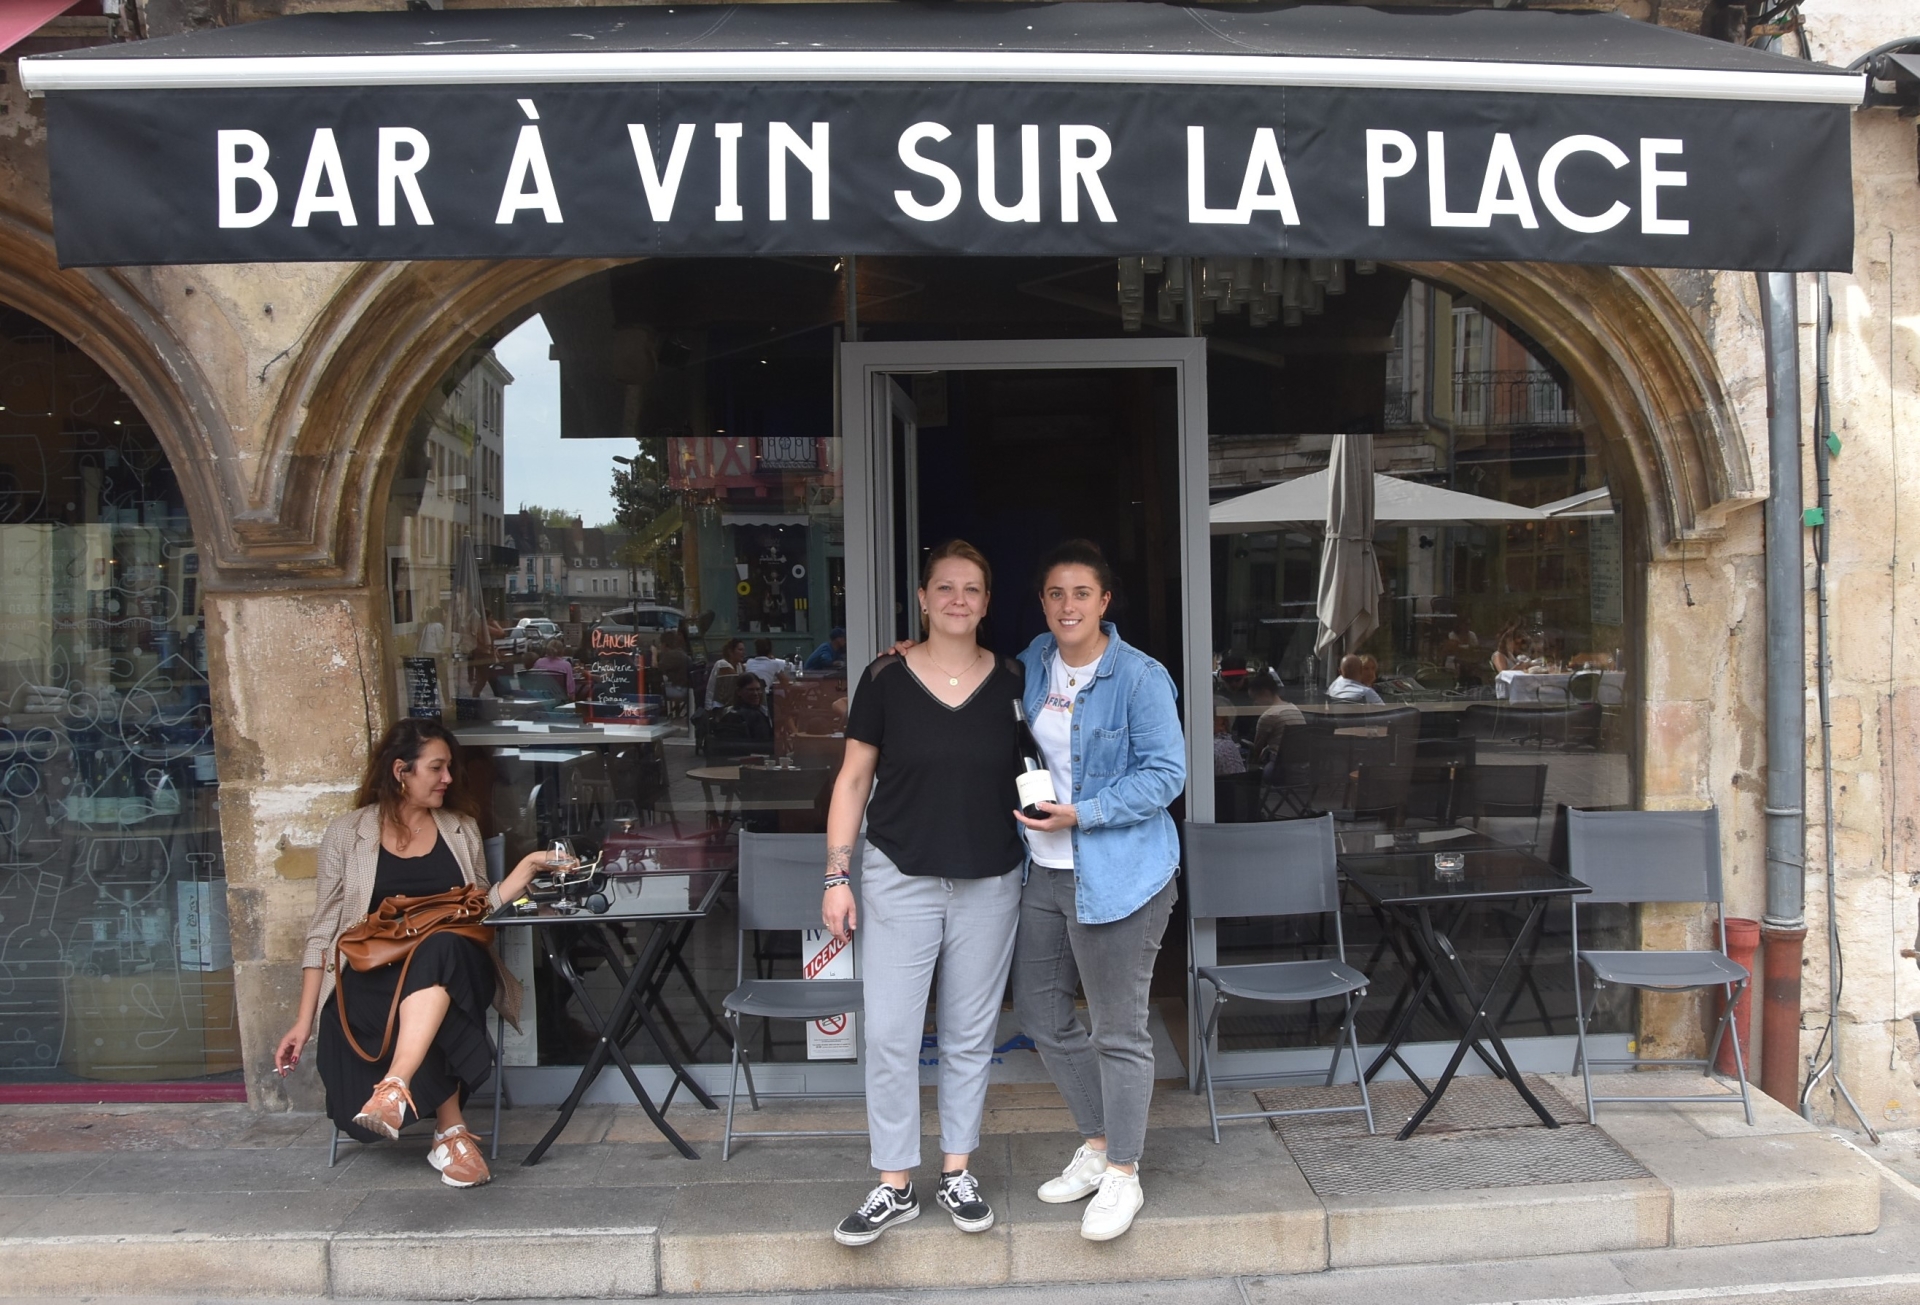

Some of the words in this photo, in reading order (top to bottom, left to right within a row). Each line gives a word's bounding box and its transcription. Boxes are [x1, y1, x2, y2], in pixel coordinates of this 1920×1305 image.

[217, 128, 435, 229] BAR
[494, 99, 564, 225] À
[626, 121, 831, 222] VIN
[893, 121, 1118, 224] SUR
[1186, 125, 1301, 226] LA
[1365, 129, 1691, 236] PLACE
[9, 603, 21, 614] 03
[591, 629, 639, 649] PLANCHE
[609, 684, 620, 694] et
[806, 928, 823, 941] IV
